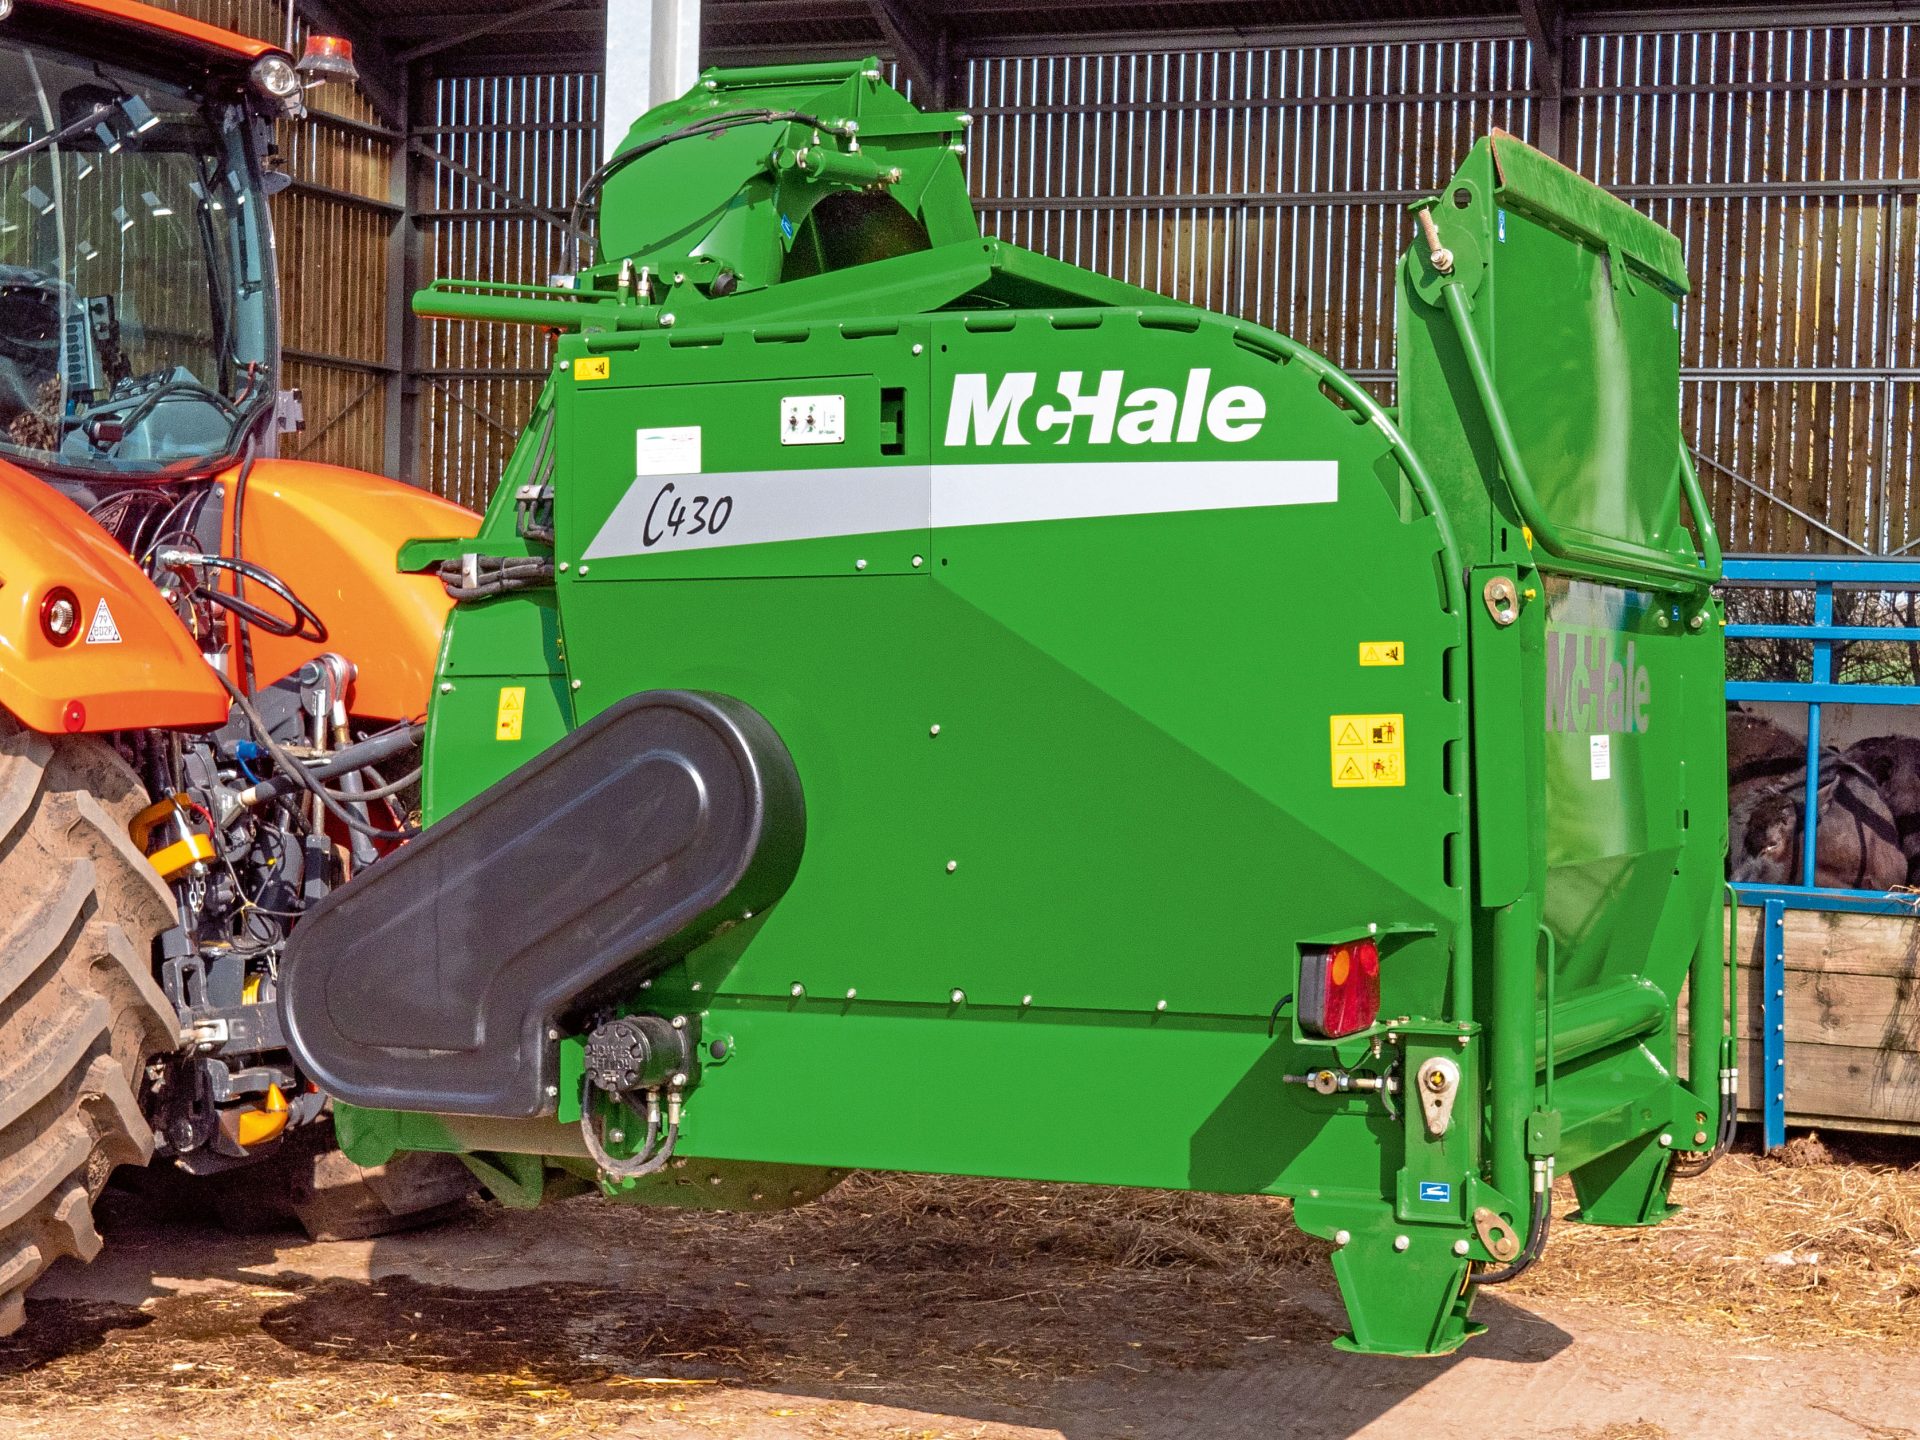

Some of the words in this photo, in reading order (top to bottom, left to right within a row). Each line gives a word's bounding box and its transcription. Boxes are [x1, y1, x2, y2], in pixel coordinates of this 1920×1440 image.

[944, 367, 1267, 446] McHale
[642, 482, 733, 547] C430
[1545, 631, 1650, 733] McHale
